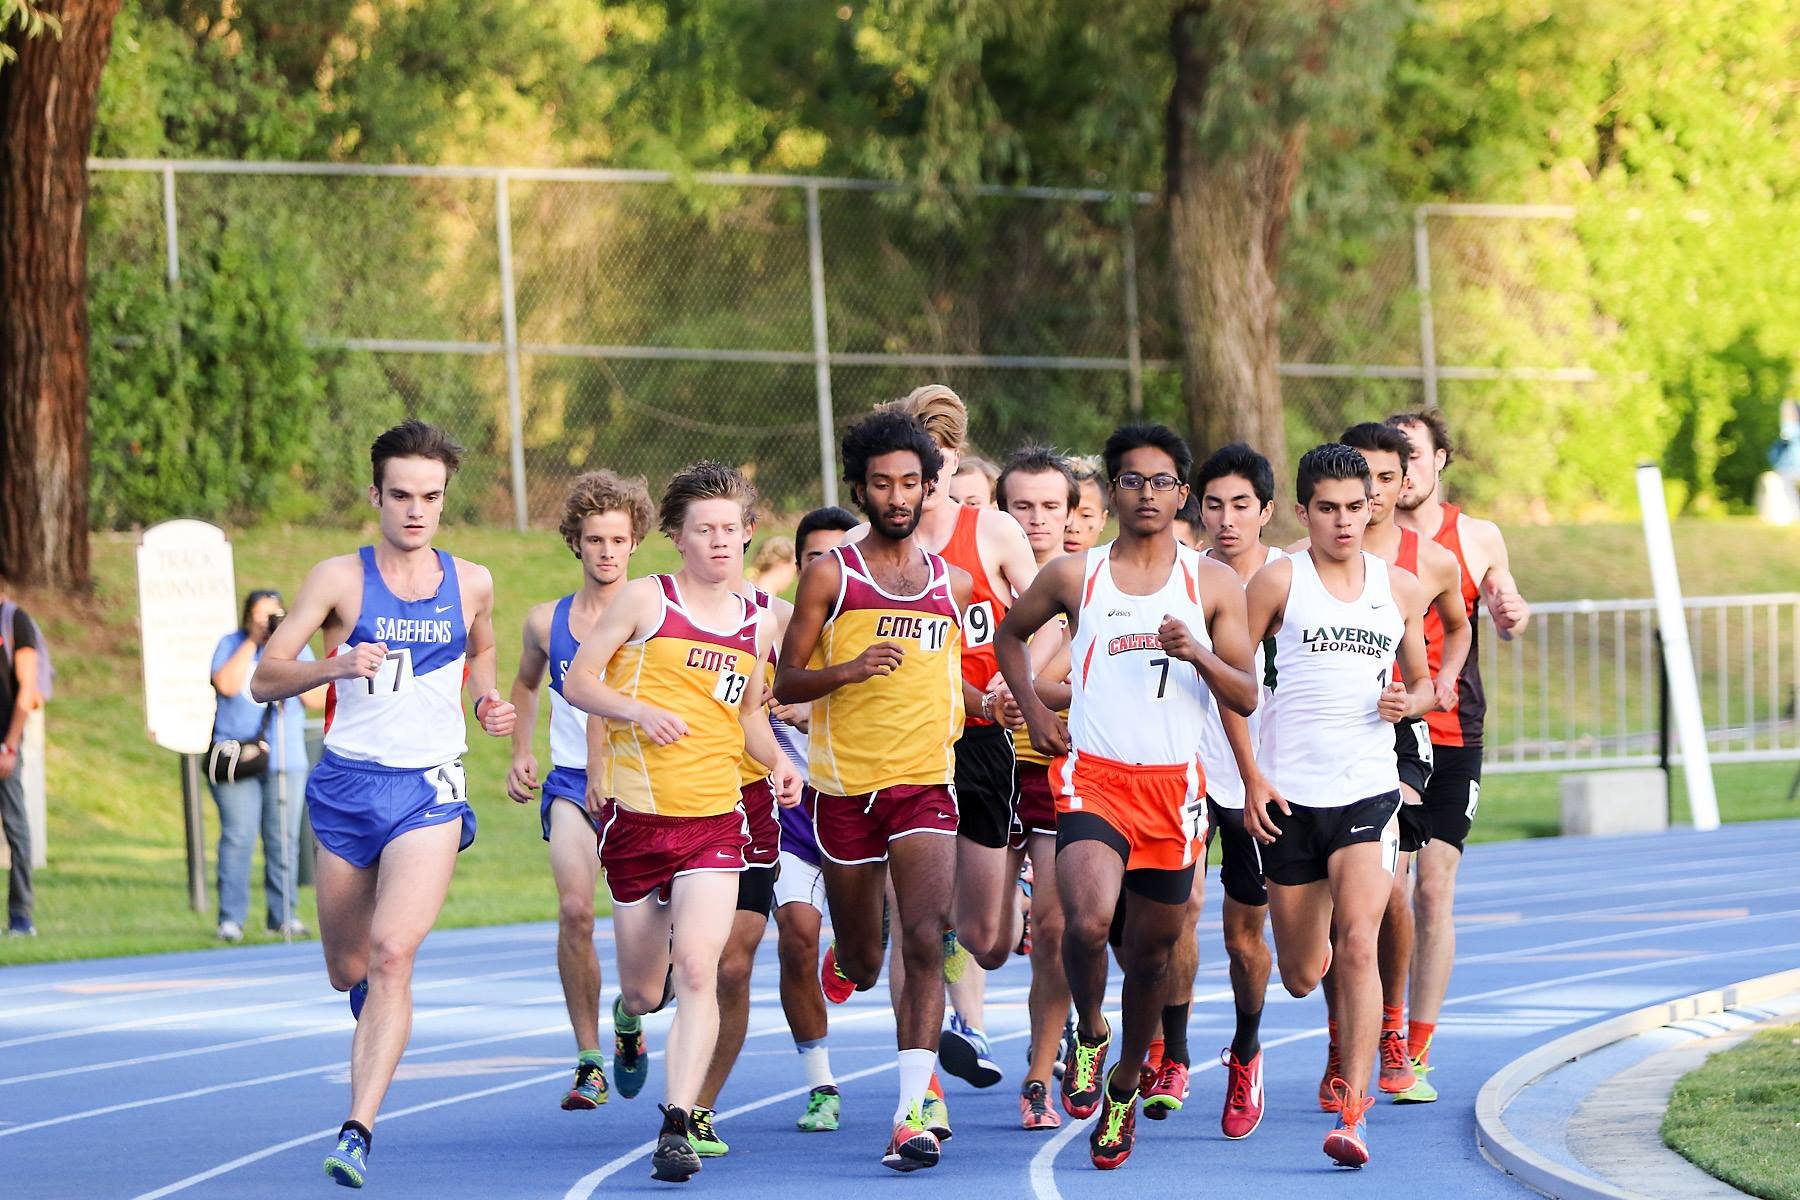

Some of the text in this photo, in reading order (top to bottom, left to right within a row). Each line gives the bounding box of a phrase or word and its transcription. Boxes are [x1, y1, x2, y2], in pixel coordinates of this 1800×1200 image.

[376, 617, 452, 643] SAGEHENS
[876, 615, 922, 639] CMS
[969, 605, 989, 644] 9
[1109, 633, 1164, 656] CALTEC
[1311, 641, 1382, 659] LEOPARDS
[686, 647, 738, 672] CMS
[723, 673, 746, 704] 13
[1150, 657, 1170, 699] 7
[1187, 802, 1202, 839] 7
